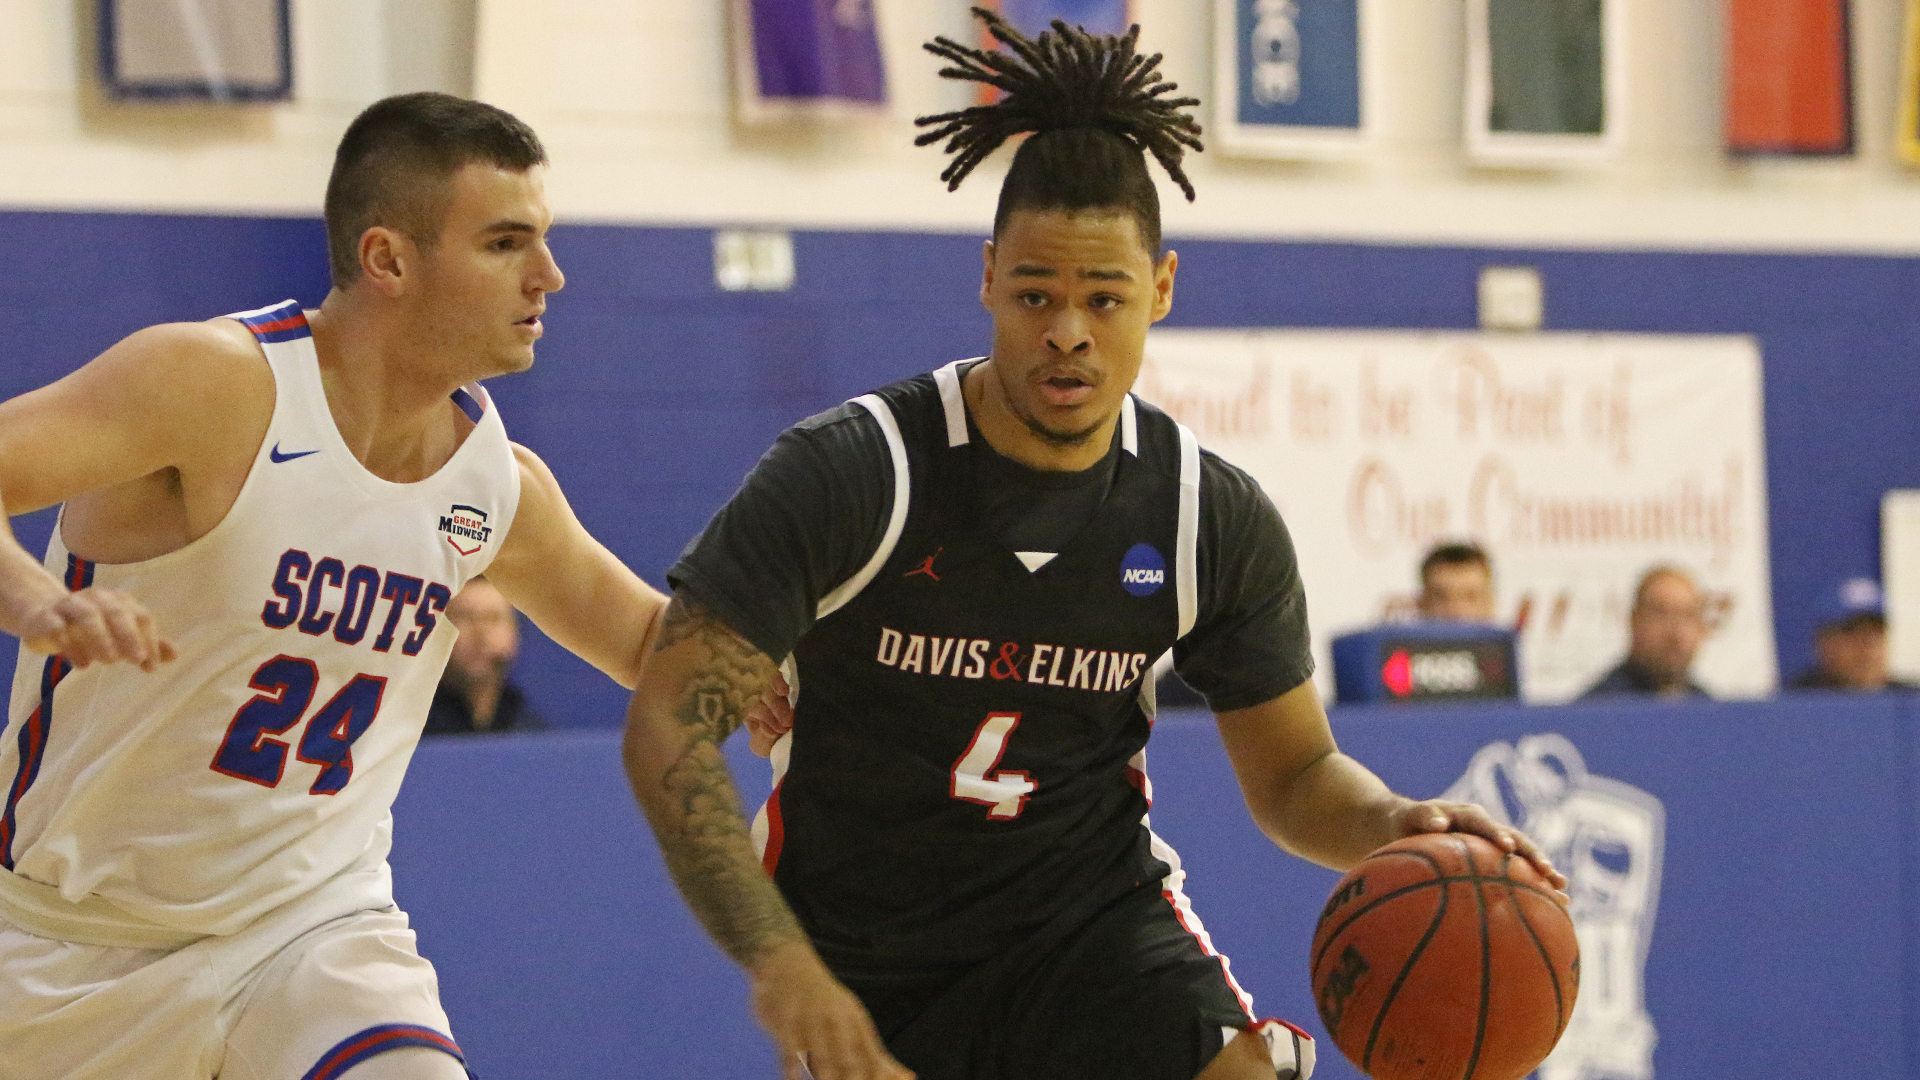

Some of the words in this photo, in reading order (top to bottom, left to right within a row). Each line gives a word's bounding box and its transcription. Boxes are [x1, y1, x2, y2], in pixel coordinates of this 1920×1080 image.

[453, 515, 483, 530] GREAT
[1123, 568, 1164, 584] NCAA
[260, 549, 452, 657] SCOTS
[209, 654, 388, 795] 24
[950, 712, 1038, 820] 4
